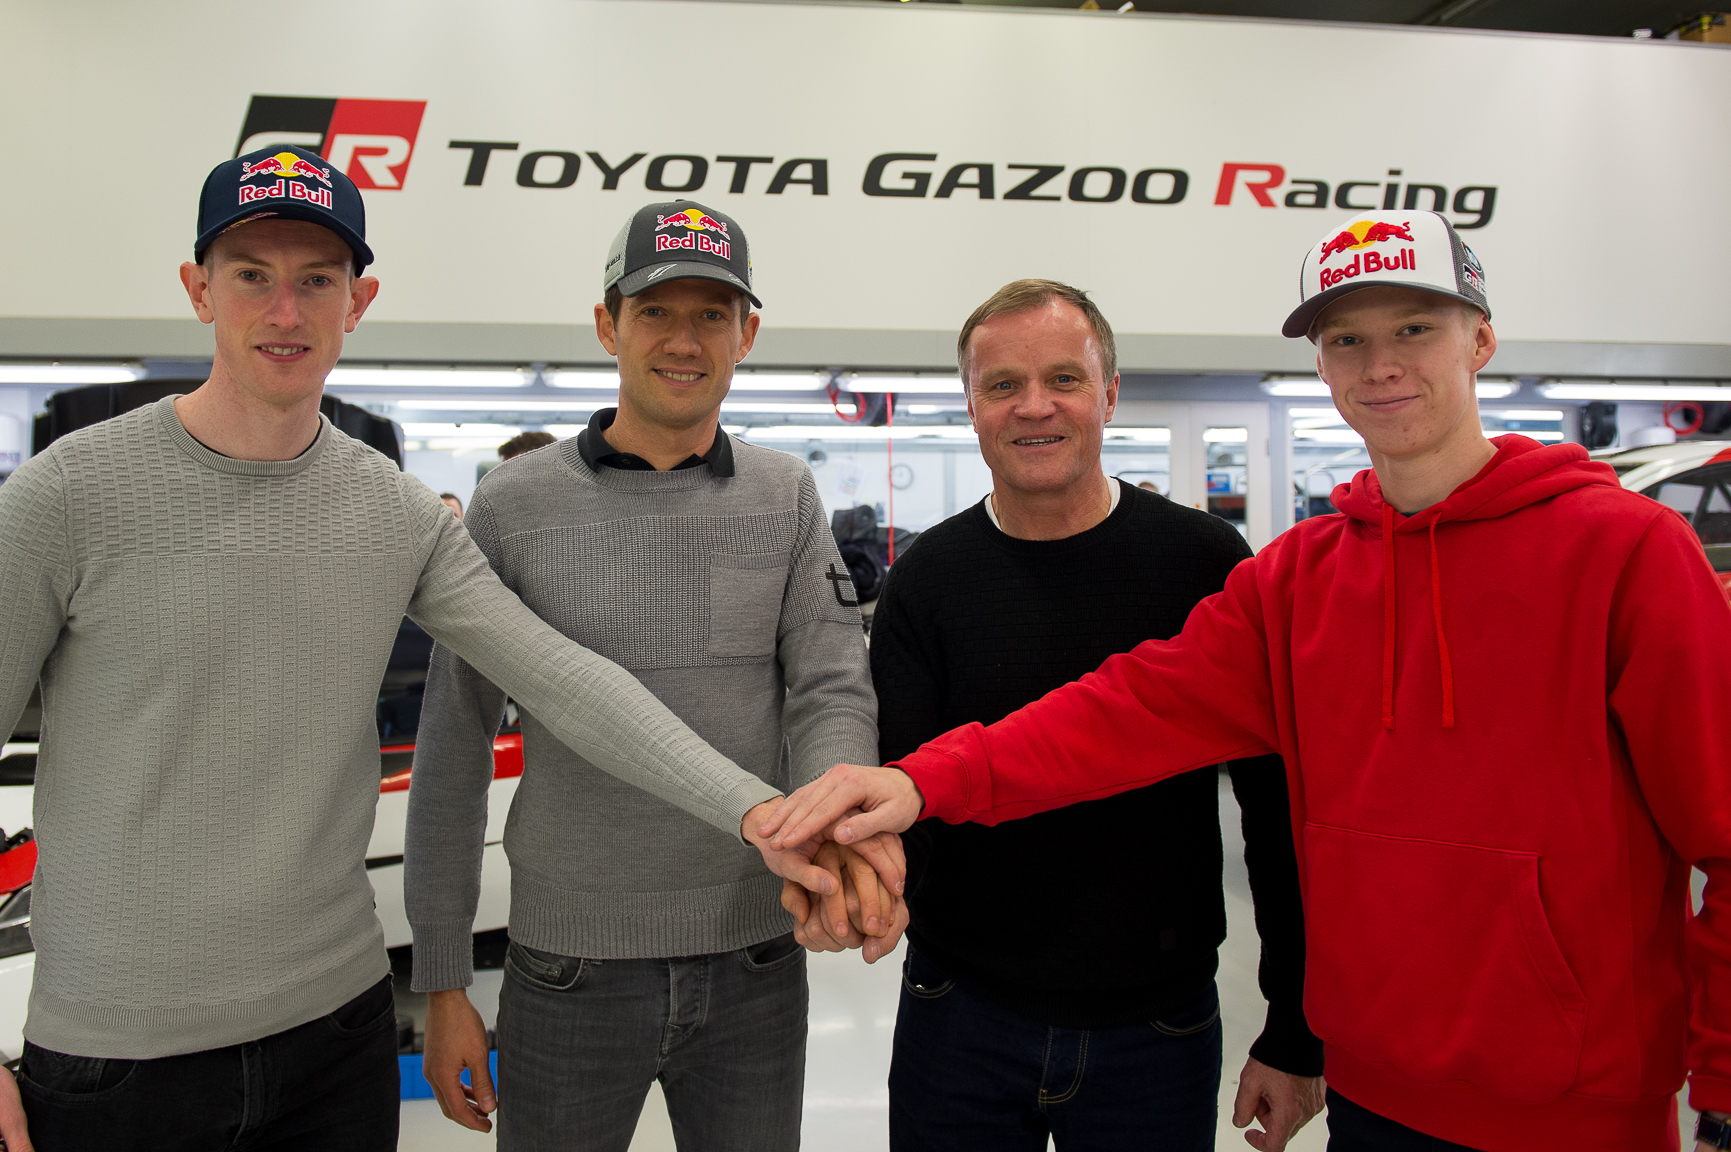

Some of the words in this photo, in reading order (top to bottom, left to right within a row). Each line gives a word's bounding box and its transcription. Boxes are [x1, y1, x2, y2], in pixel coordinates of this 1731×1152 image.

[239, 179, 285, 205] Red
[289, 180, 333, 210] Bull
[447, 140, 830, 196] TOYOTA
[862, 151, 1190, 205] GAZOO
[1213, 161, 1499, 230] Racing
[656, 231, 695, 252] Red
[698, 233, 731, 260] Bull
[1319, 253, 1361, 292] Red
[1363, 247, 1416, 274] Bull
